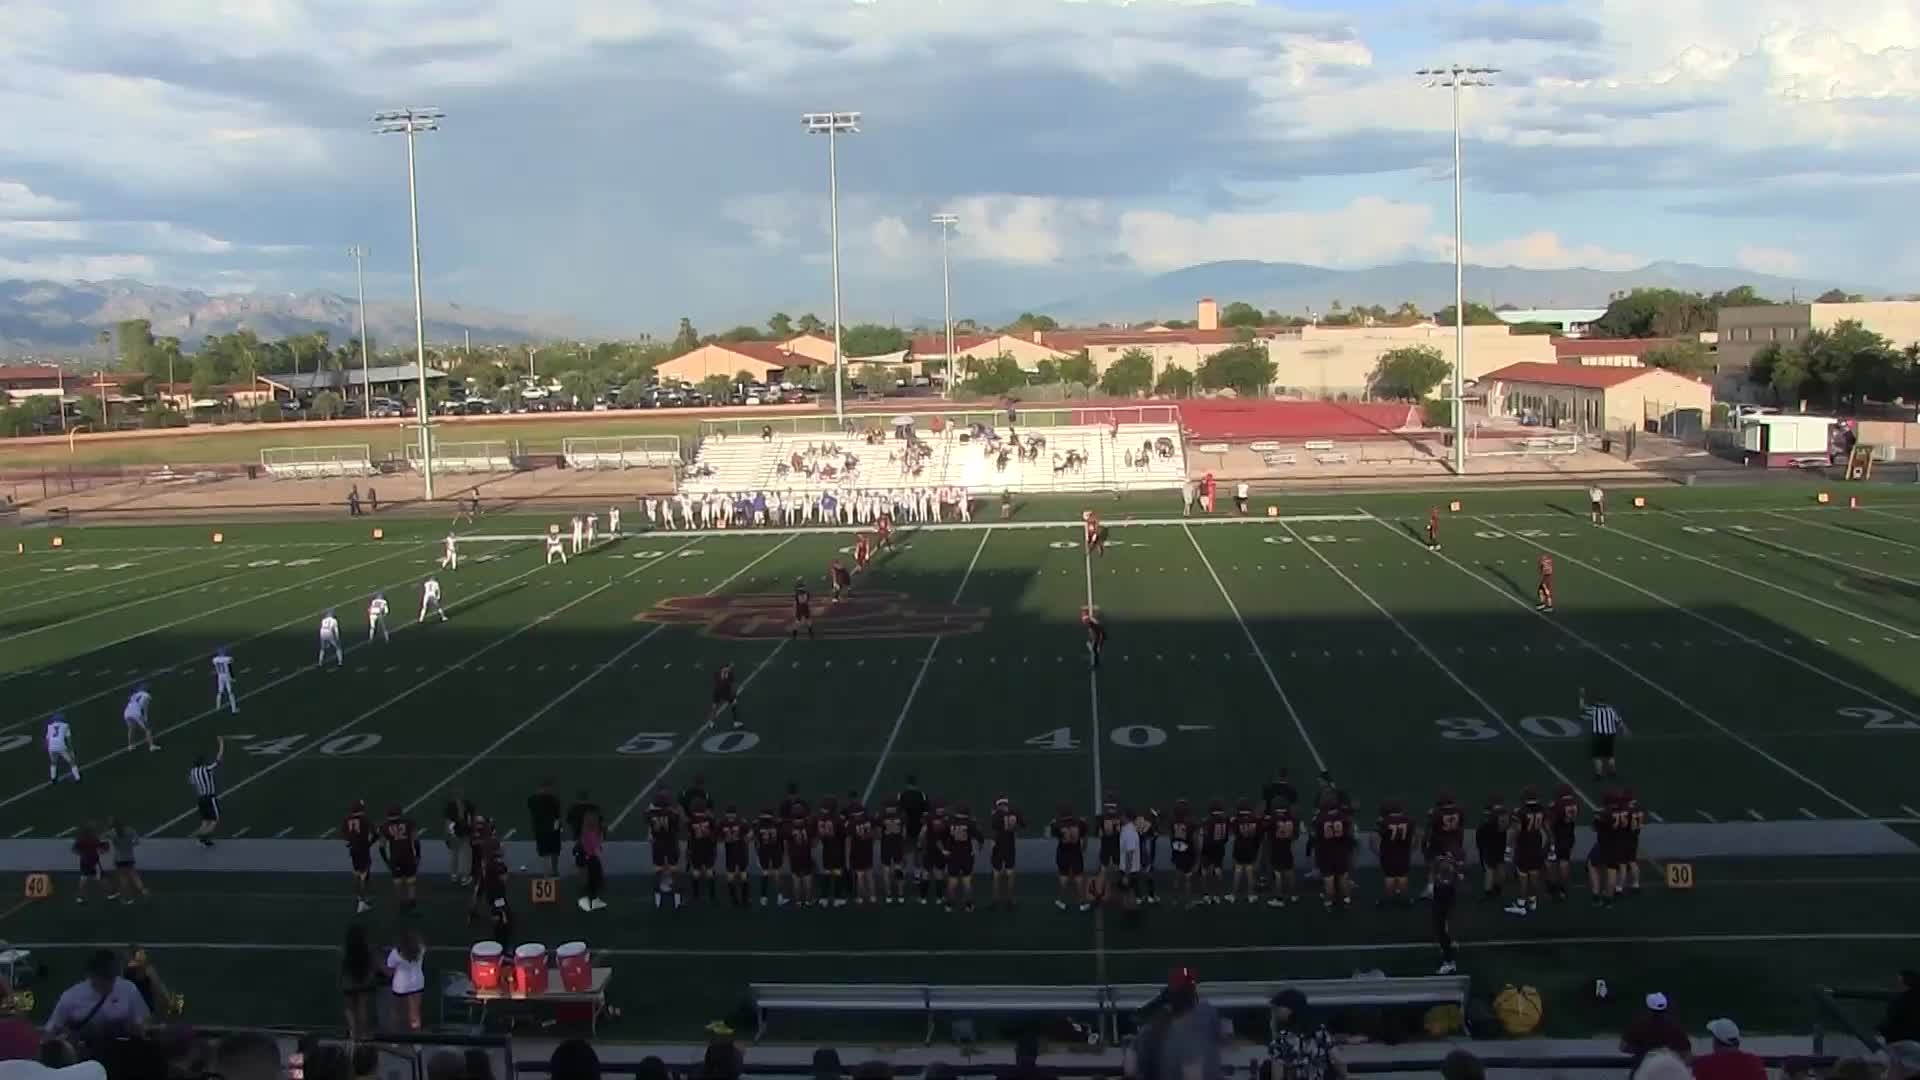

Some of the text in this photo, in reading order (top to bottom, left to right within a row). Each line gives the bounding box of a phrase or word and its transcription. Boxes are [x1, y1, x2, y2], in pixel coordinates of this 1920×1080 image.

[1671, 867, 1689, 884] 30
[28, 877, 44, 895] 40
[535, 880, 551, 898] 50
